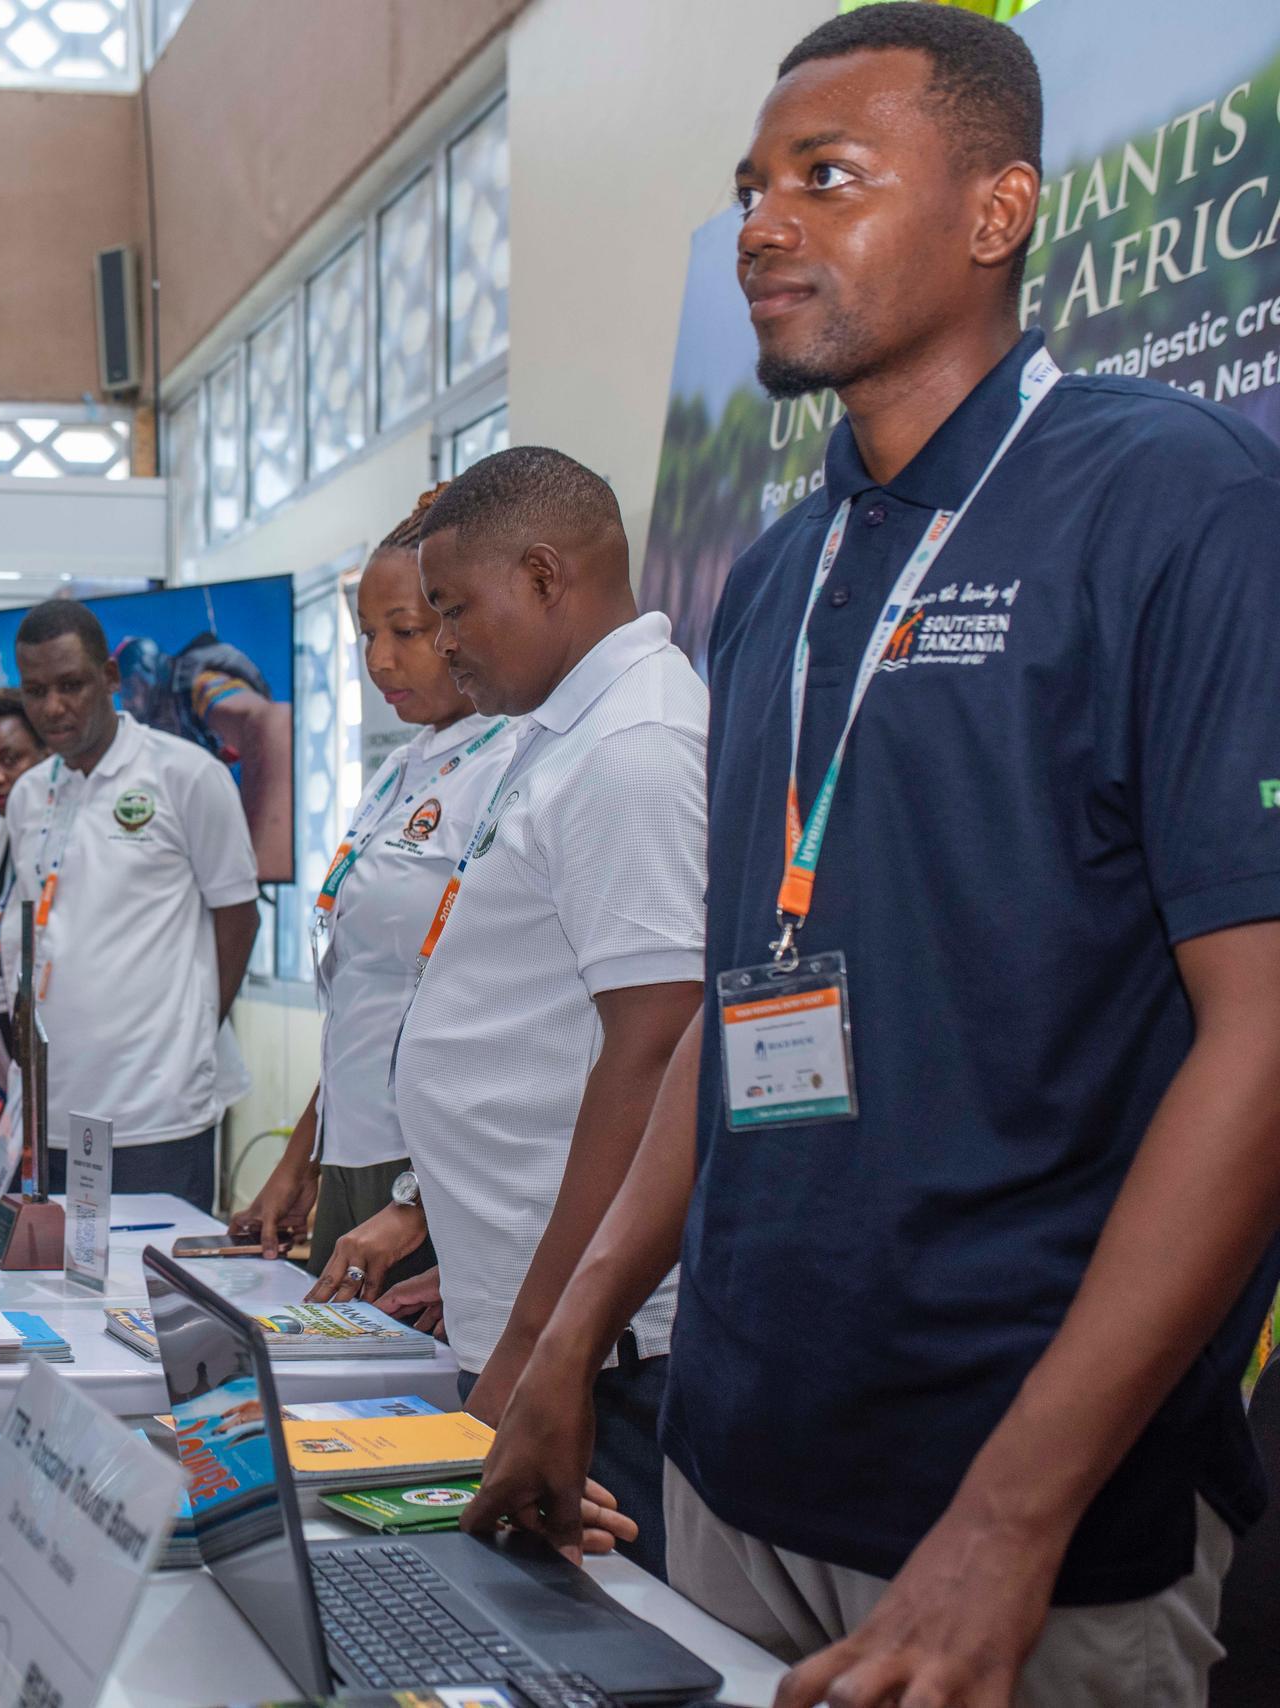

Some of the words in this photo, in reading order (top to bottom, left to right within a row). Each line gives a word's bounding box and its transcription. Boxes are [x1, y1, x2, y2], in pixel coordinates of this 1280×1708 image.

[1095, 310, 1229, 379] majestic
[921, 613, 1011, 632] SOUTHERN
[918, 633, 1006, 652] TANZANIA
[439, 890, 457, 923] 2025
